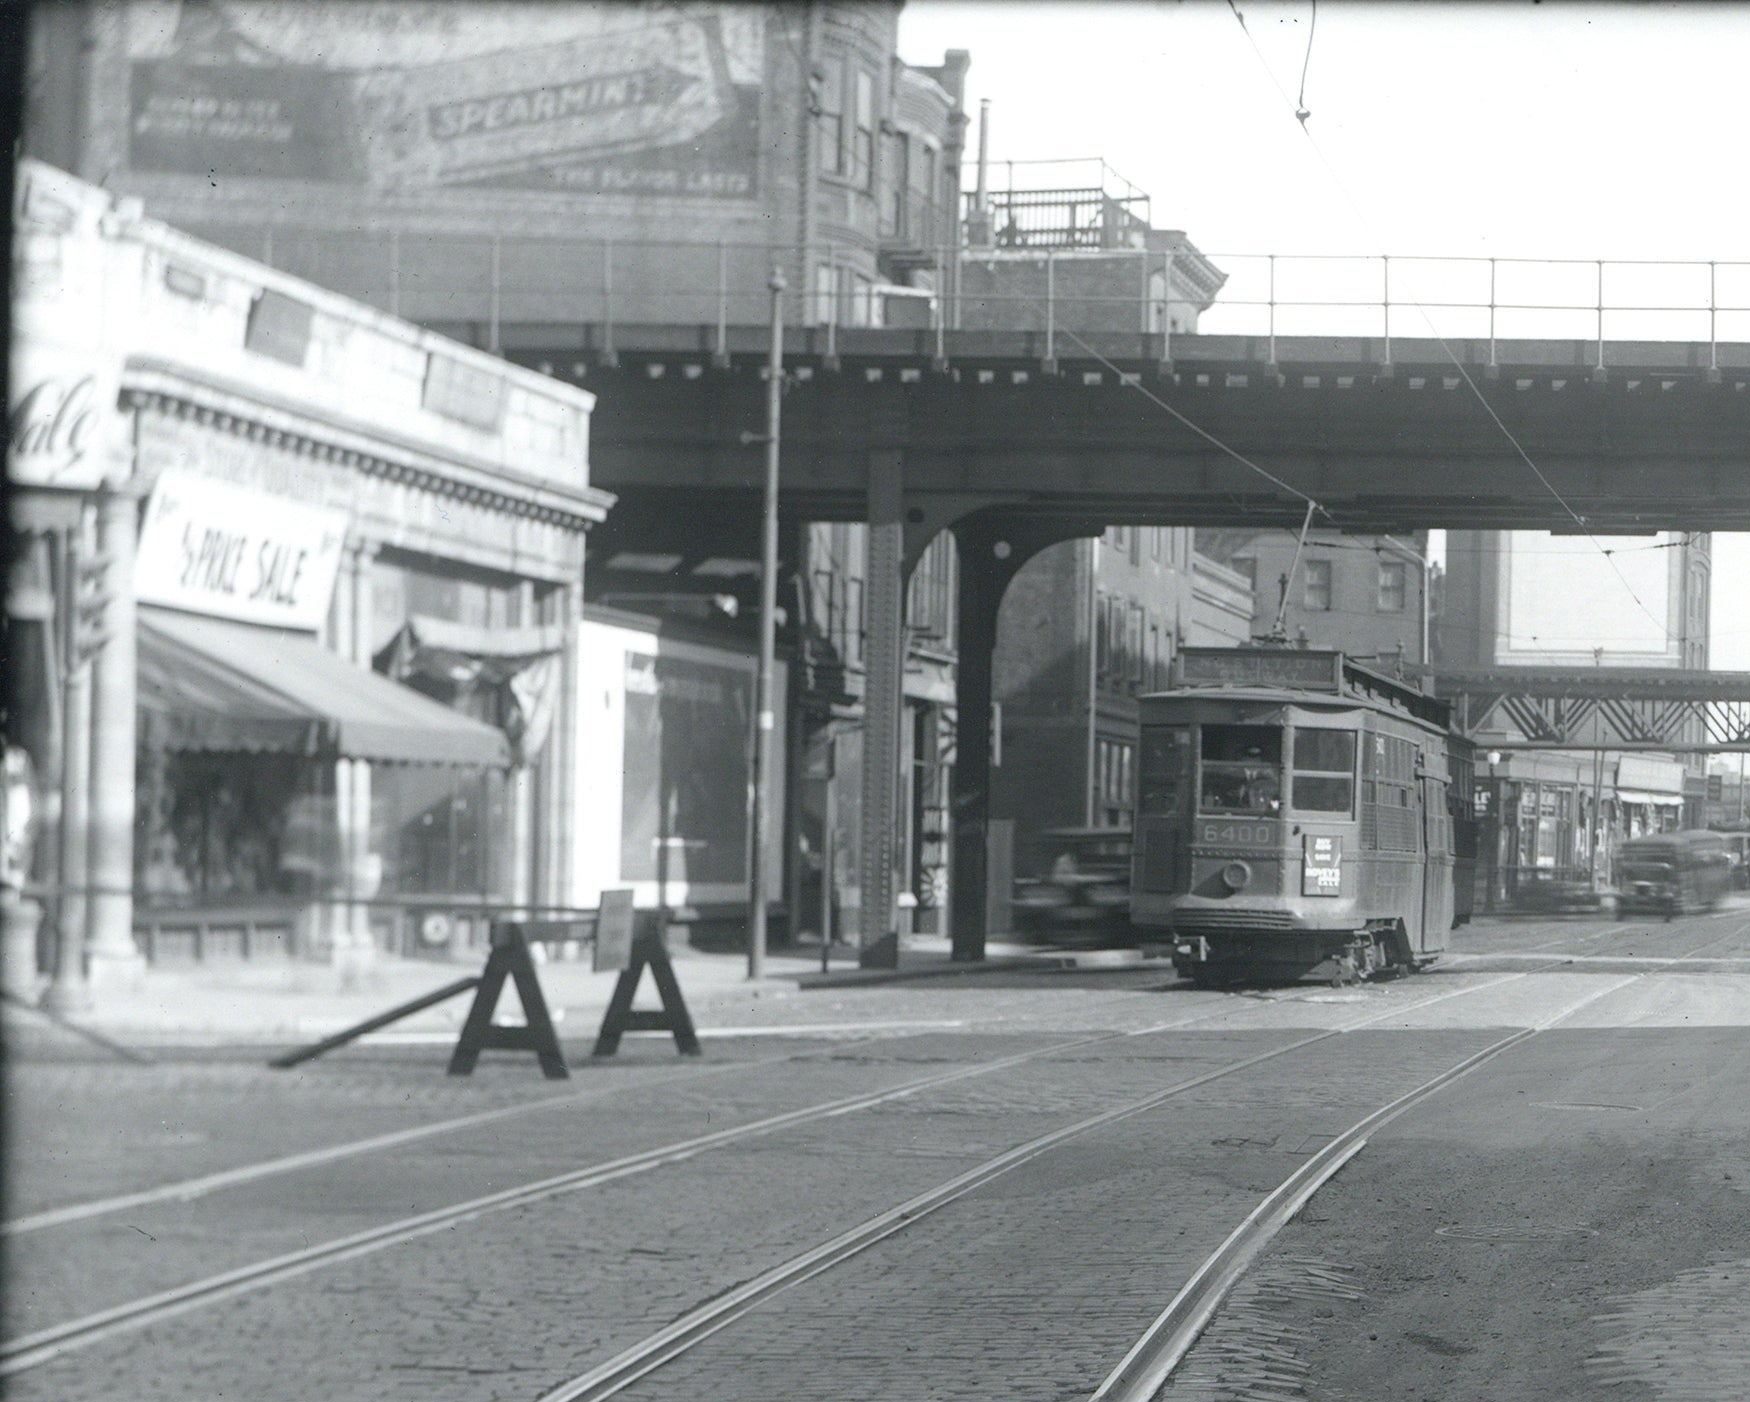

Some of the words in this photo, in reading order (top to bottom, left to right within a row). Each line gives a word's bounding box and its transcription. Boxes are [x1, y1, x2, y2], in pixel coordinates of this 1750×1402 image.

[439, 75, 647, 137] SPEARMINT
[193, 527, 248, 596] PRICE
[248, 536, 309, 607] SALE
[1204, 824, 1270, 843] 6400
